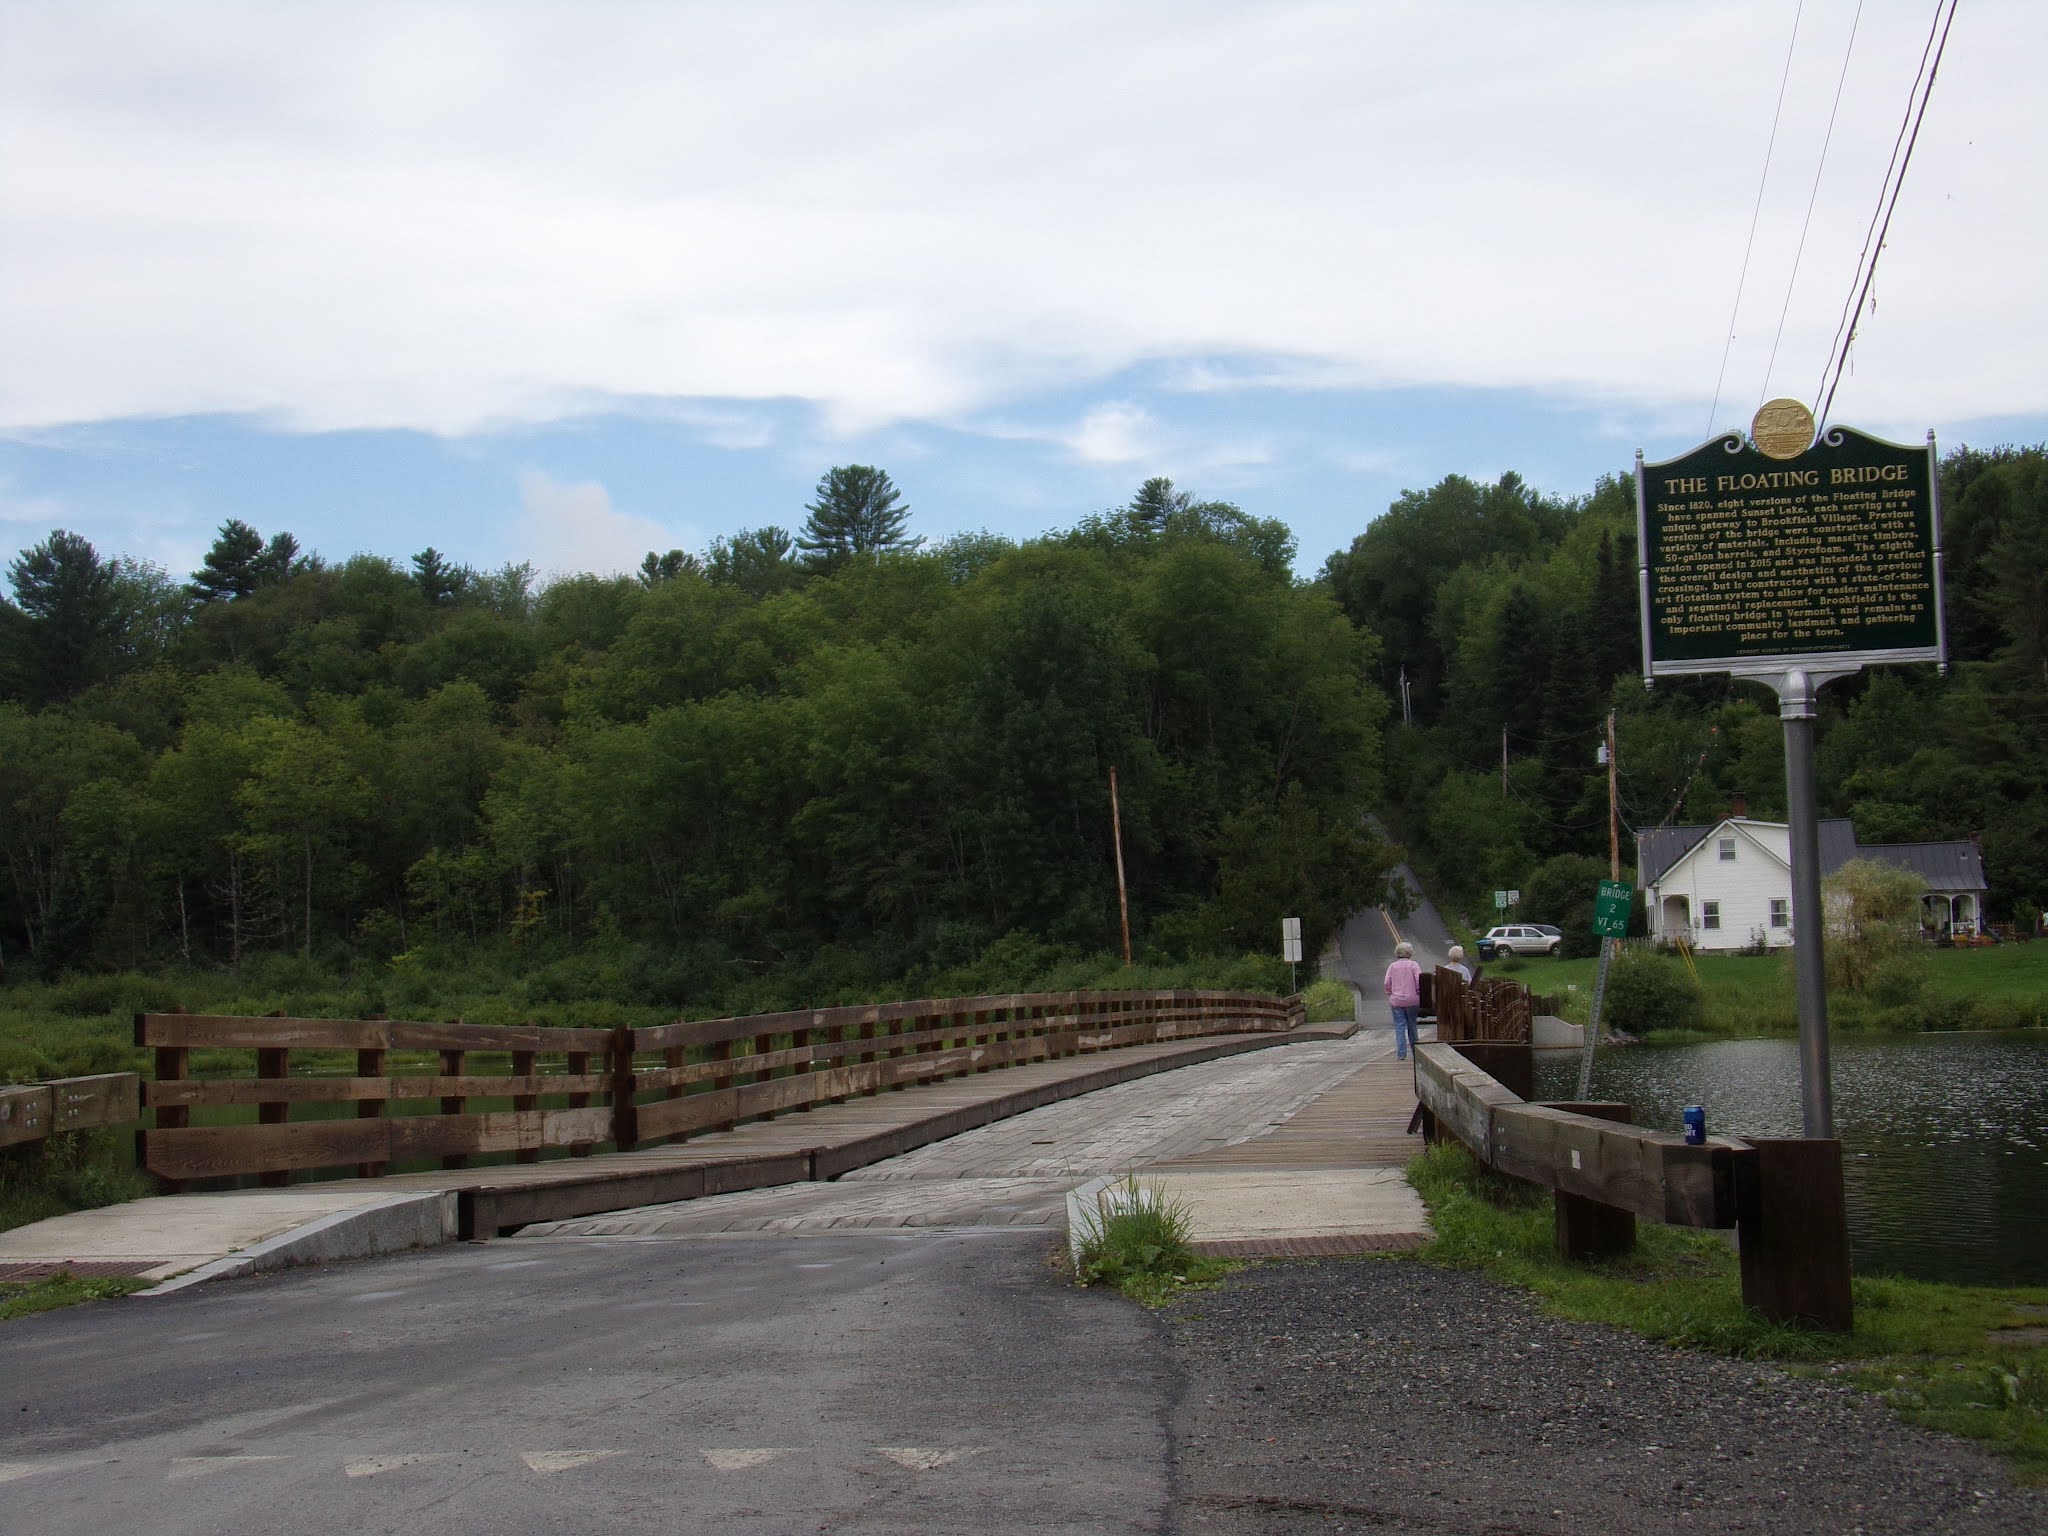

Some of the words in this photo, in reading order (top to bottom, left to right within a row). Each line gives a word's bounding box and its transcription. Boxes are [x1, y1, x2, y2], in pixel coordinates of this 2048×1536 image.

[1665, 477, 1707, 494] THE
[1718, 470, 1819, 491] FLOATING
[1830, 465, 1908, 484] BRIDGE
[1690, 501, 1713, 509] 1820,
[1718, 499, 1744, 508] eight
[1750, 497, 1791, 506] versions
[1795, 495, 1807, 503] of
[1834, 492, 1877, 501] Floating
[1882, 489, 1916, 498] Bridge
[1662, 523, 1697, 532] unique
[1701, 521, 1741, 531] gateway
[1762, 515, 1817, 525] Brookfield
[1821, 514, 1861, 522] Village.
[1869, 510, 1914, 519] Previous
[1696, 510, 1737, 521] spanned
[1742, 507, 1775, 517] Sunset
[1780, 506, 1807, 514] Lake,
[1815, 504, 1838, 512] each
[1843, 501, 1882, 510] serving
[1663, 533, 1704, 541] versions
[1747, 529, 1779, 537] bridge
[1785, 527, 1808, 535] were
[1814, 522, 1876, 533] constructed
[1881, 521, 1904, 529] with
[1660, 544, 1698, 552] variety
[1718, 539, 1769, 549] materials,
[1775, 536, 1821, 546] including
[1828, 534, 1868, 542] massive
[1873, 531, 1919, 539] timbers,
[1665, 552, 1713, 562] 50-gallon
[1718, 550, 1757, 559] barrels,
[1763, 548, 1781, 556] and
[1786, 546, 1845, 556] Styrofoam.
[1855, 543, 1875, 552] The
[1880, 541, 1914, 550] eighth
[1655, 565, 1692, 573] version
[1696, 561, 1733, 571] opened
[1750, 559, 1771, 567] 2015
[1775, 557, 1794, 566] and
[1821, 553, 1868, 564] intended
[1889, 550, 1926, 559] reflect
[1660, 575, 1676, 583] the
[1680, 572, 1716, 581] overall
[1720, 571, 1752, 580] design
[1758, 569, 1776, 577] and
[1781, 566, 1834, 576] aesthetics
[1839, 565, 1850, 573] of
[1855, 564, 1872, 572] the
[1877, 562, 1923, 572] previous
[1659, 584, 1708, 593] crossings,
[1713, 582, 1731, 590] but
[1747, 577, 1809, 589] constructed
[1814, 576, 1836, 584] with
[1852, 573, 1923, 582] state-of-the-
[1675, 593, 1722, 602] flotation
[1725, 591, 1759, 600] system
[1778, 589, 1804, 597] allow
[1827, 586, 1859, 594] easier
[1864, 582, 1929, 592] maintenance
[1666, 605, 1684, 613] and
[1689, 601, 1741, 613] segmental
[1746, 599, 1812, 610] replacement.
[1820, 593, 1883, 605] Brookfield's
[1888, 593, 1896, 601] is
[1661, 615, 1683, 624] only
[1689, 613, 1730, 622] floating
[1734, 610, 1767, 620] bridge
[1787, 607, 1834, 617] Vermont,
[1840, 606, 1859, 614] and
[1865, 604, 1906, 612] remains
[1670, 623, 1722, 635] important
[1726, 621, 1784, 630] community
[1789, 618, 1836, 627] landmark
[1842, 616, 1860, 624] and
[1866, 614, 1915, 625] gathering
[1741, 631, 1768, 641] place
[1772, 631, 1788, 639] for
[1794, 629, 1811, 637] the
[1602, 887, 1630, 900] BRIDGE
[1610, 904, 1616, 913] 2
[1598, 917, 1608, 926] VT
[1613, 920, 1624, 930] 65
